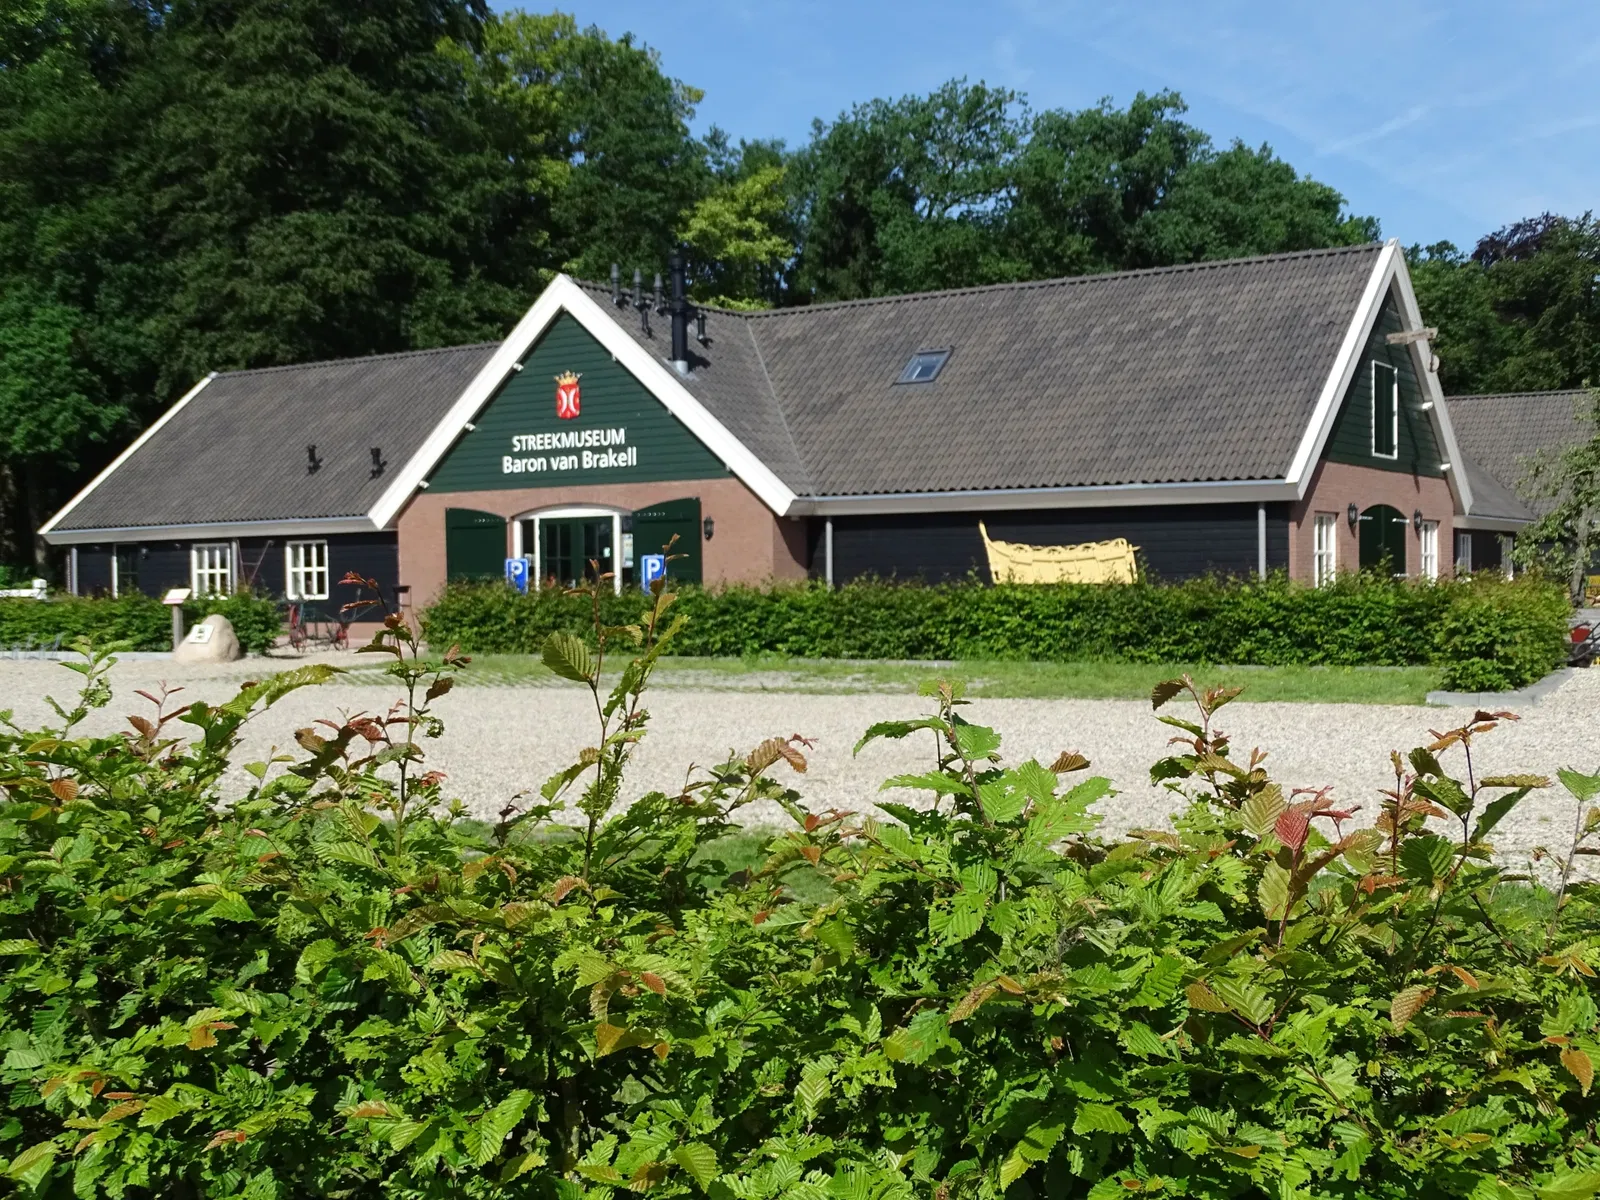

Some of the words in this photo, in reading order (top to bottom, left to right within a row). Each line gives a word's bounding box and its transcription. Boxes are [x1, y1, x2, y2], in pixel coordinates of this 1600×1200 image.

[512, 428, 625, 452] STREEKMUSEUM
[502, 455, 547, 474] Baron
[549, 455, 579, 471] van
[582, 446, 637, 469] Brakell
[511, 561, 523, 581] P
[647, 558, 661, 579] P
